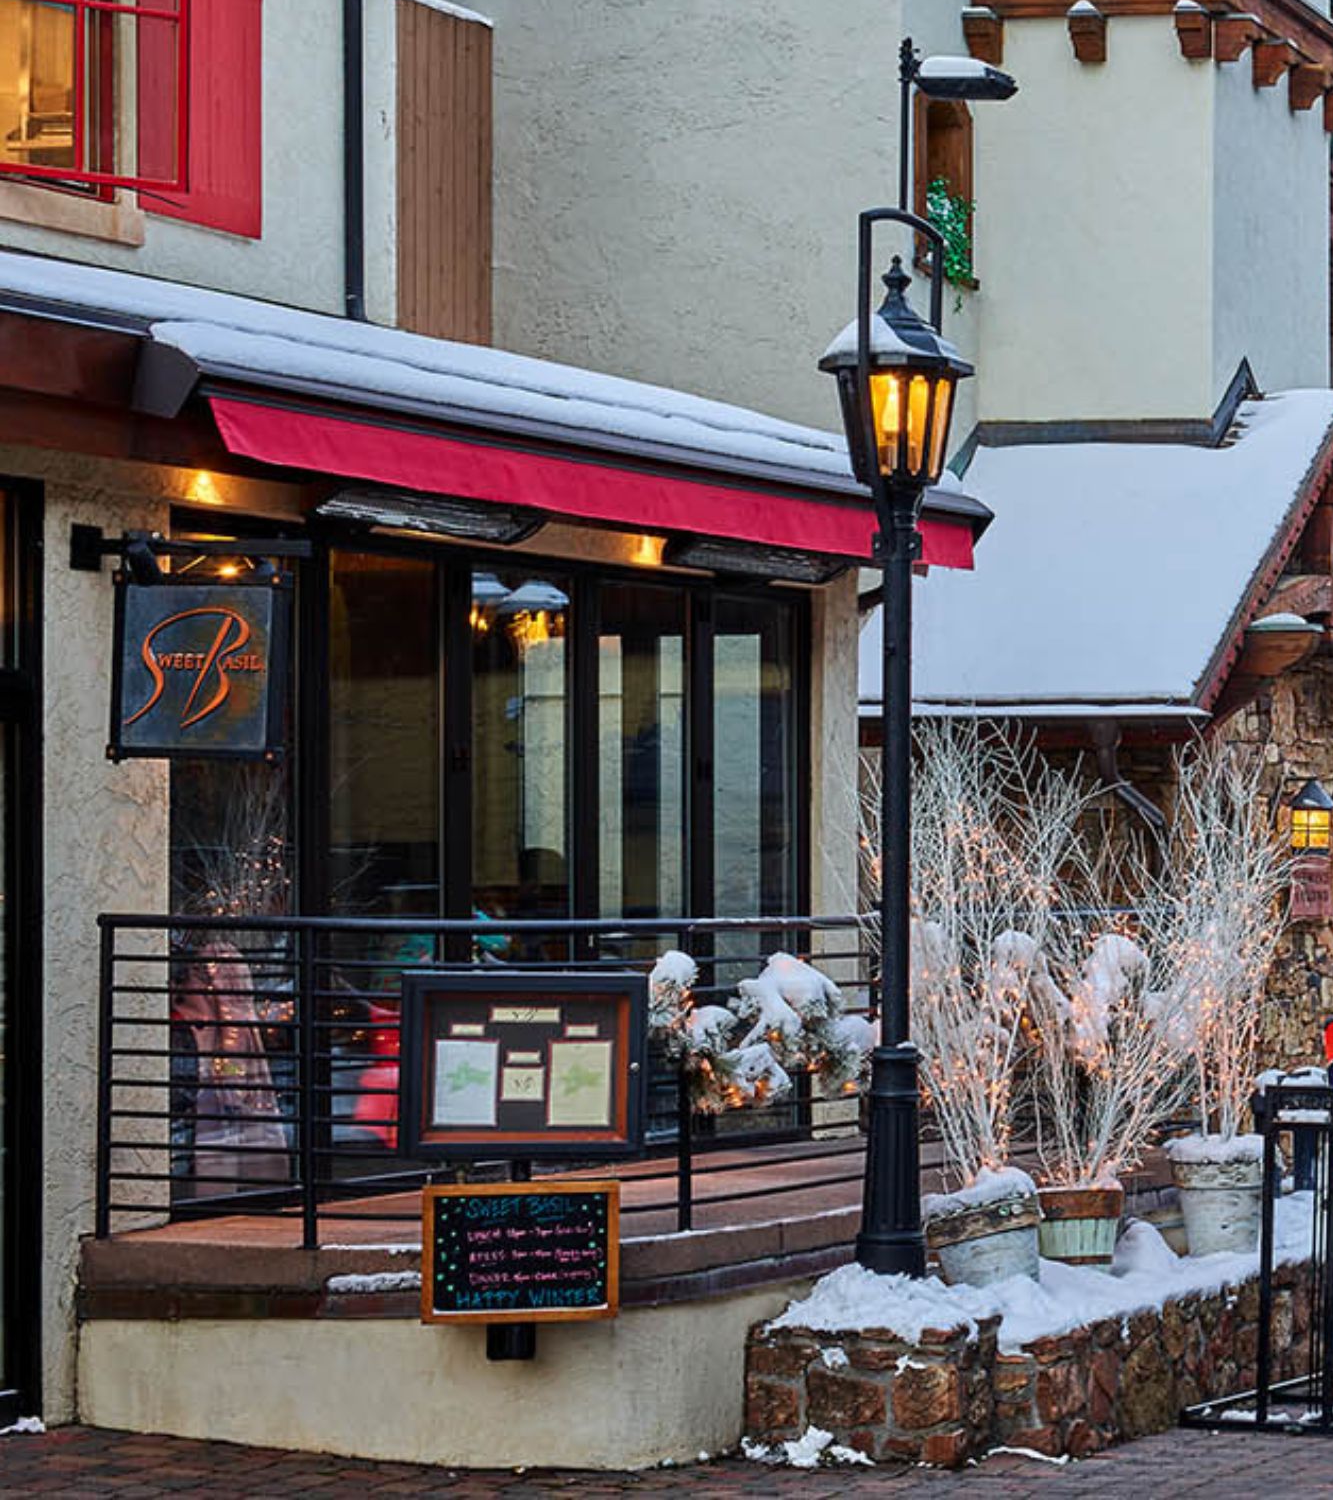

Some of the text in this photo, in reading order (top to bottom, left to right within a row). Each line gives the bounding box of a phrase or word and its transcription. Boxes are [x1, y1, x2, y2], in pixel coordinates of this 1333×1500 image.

[466, 1196, 574, 1218] SWEET BASIL
[528, 1286, 601, 1306] WINTER
